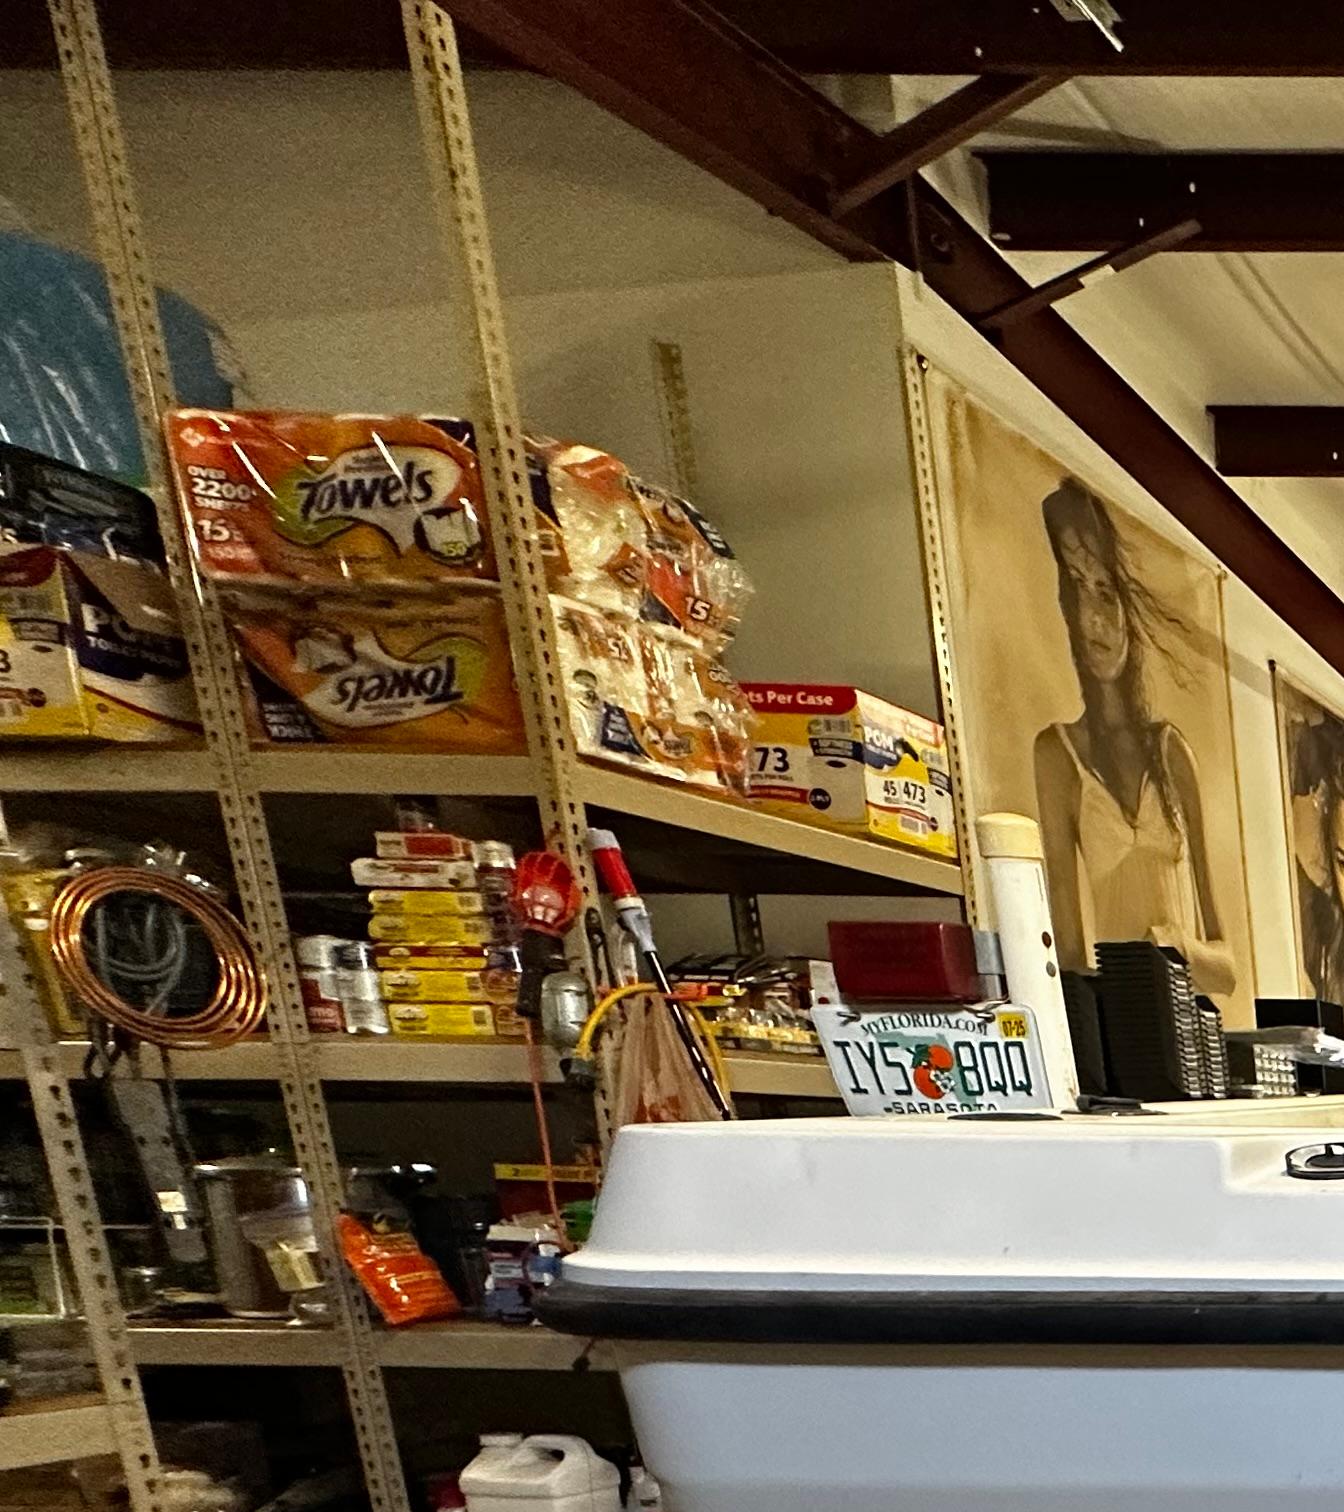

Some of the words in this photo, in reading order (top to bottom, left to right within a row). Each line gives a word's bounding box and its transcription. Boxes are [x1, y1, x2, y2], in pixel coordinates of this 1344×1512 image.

[297, 461, 432, 522] Towels
[331, 654, 464, 713] Towels
[766, 690, 793, 704] Per
[796, 691, 834, 706] Case
[864, 727, 895, 752] POM
[750, 746, 791, 775] 73
[883, 780, 897, 797] 45
[903, 781, 926, 805] 473
[860, 1011, 989, 1037] MYFLORIDA.COM
[1001, 1018, 1027, 1038] 07-25
[952, 1040, 1034, 1097] 8QQ
